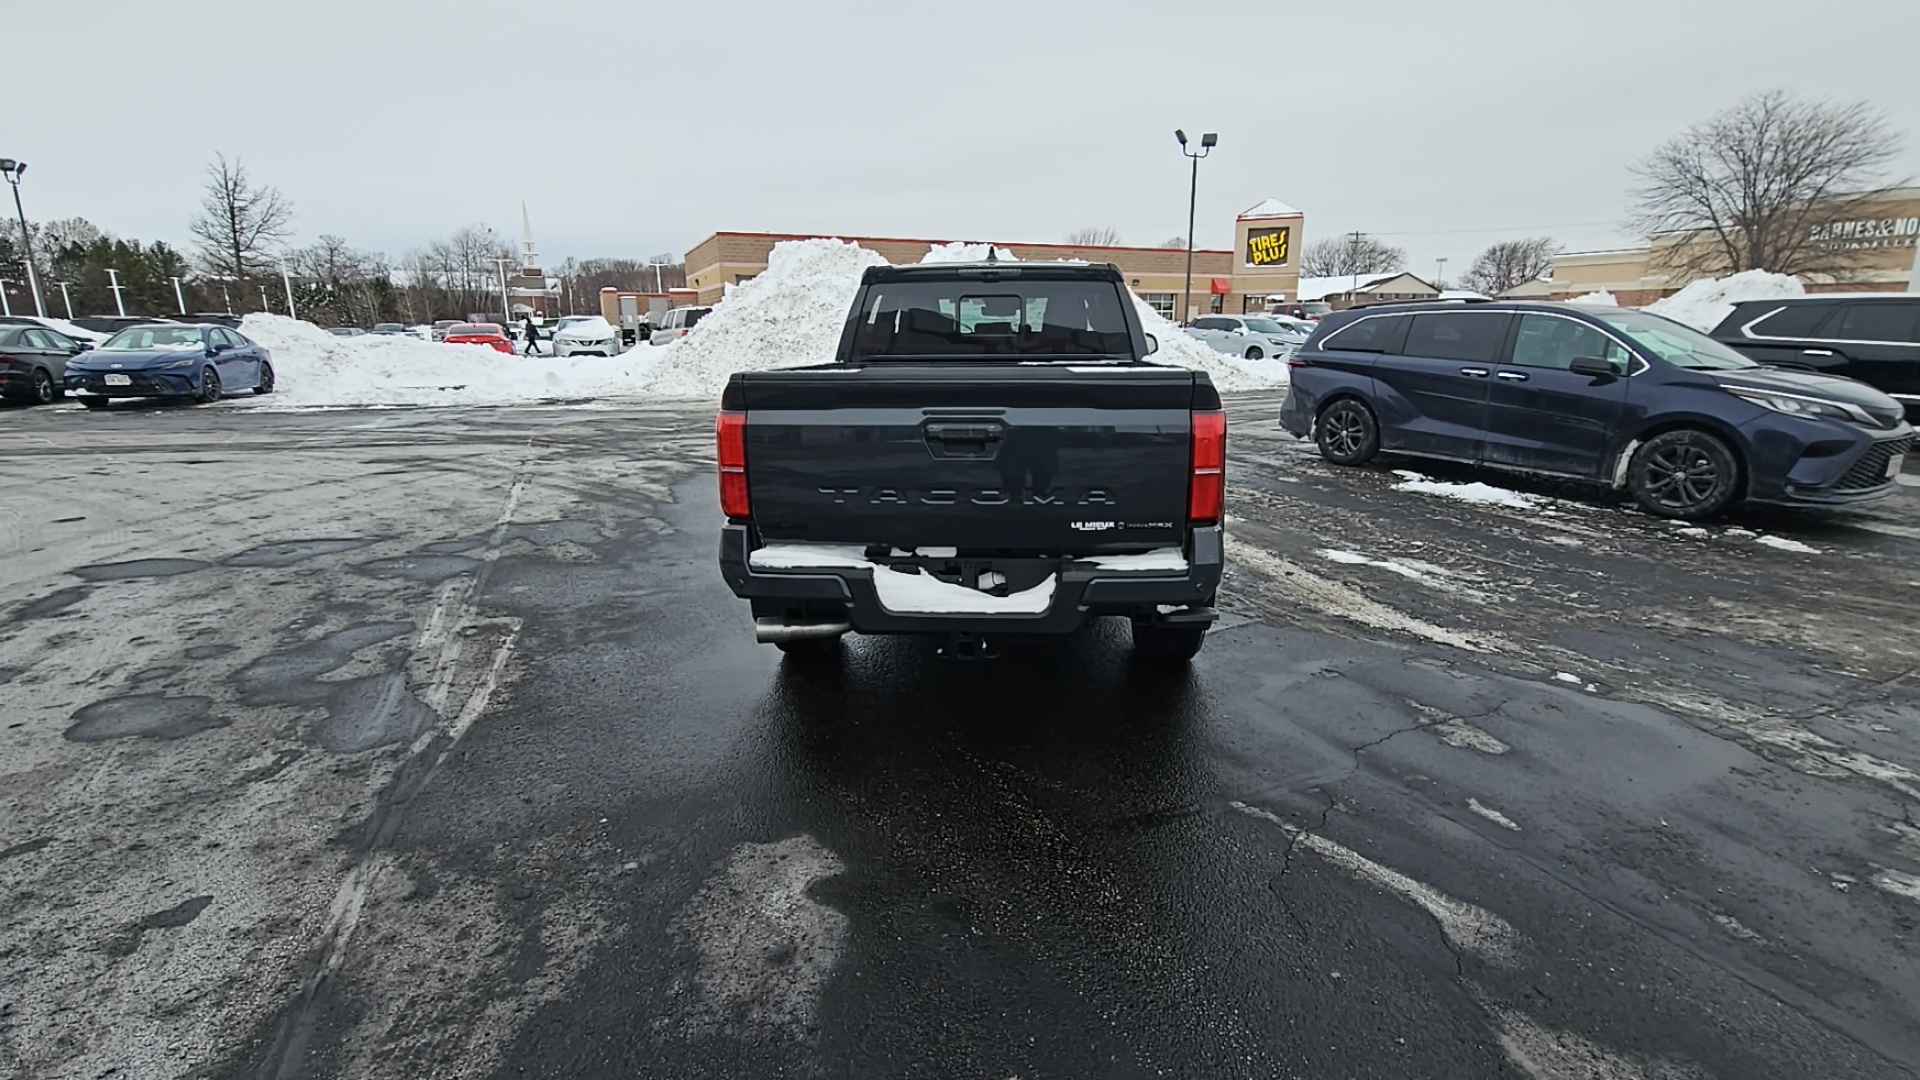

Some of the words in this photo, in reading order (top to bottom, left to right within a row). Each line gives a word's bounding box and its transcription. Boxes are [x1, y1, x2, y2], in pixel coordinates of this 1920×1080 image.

[1249, 230, 1286, 252] TIRES
[1253, 244, 1287, 264] PLUS
[818, 487, 1116, 505] TACOMA
